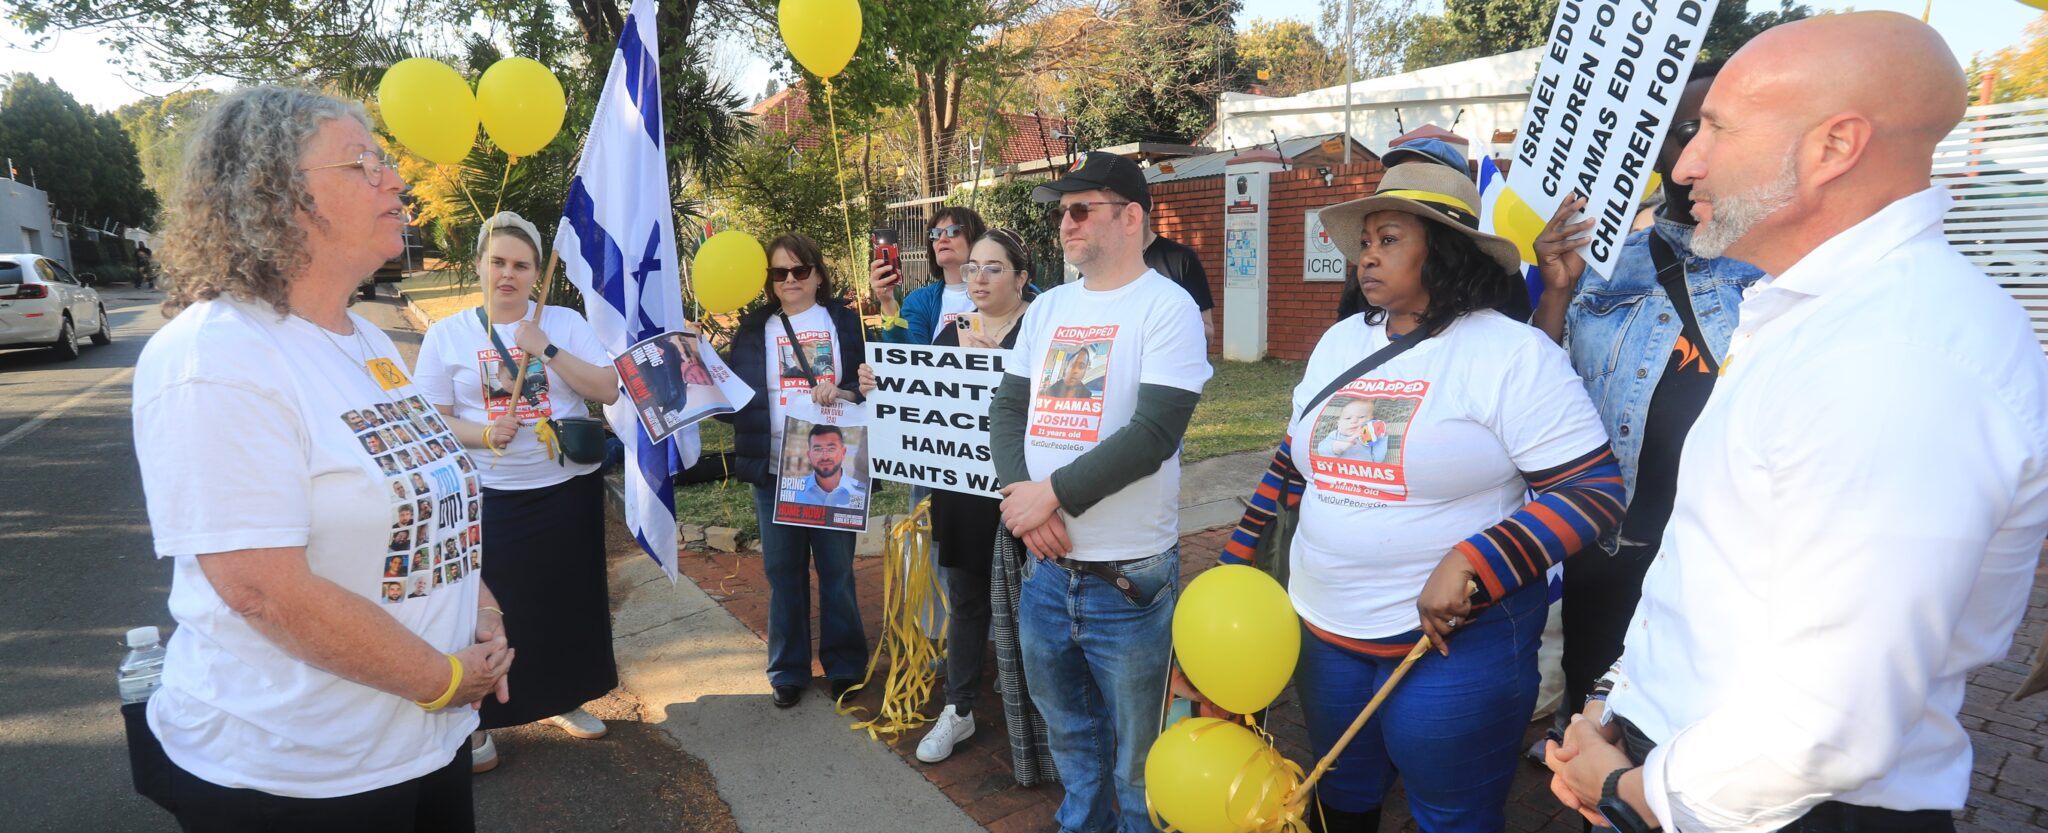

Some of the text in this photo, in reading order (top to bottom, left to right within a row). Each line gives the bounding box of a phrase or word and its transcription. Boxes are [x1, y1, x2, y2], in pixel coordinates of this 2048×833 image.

[1518, 0, 1584, 168] ISRAEL EDU
[1542, 0, 1622, 198] CHILDREN FO
[1590, 0, 1706, 263] CHILDREN FOR D
[1574, 107, 1618, 214] HAMAS
[1307, 258, 1343, 274] ICRC
[1057, 327, 1114, 339] KIDNPPED
[631, 347, 648, 365] HIM
[642, 341, 664, 367] BRING
[874, 347, 1006, 373] ISRAEL
[1036, 398, 1102, 413] BY HAMAS
[1037, 413, 1089, 429] JOSHUA
[1046, 429, 1066, 438] years
[1068, 430, 1082, 438] old
[902, 434, 991, 462] HAMAS
[872, 457, 1002, 493] WANTS WA
[1316, 460, 1396, 481] BY HAMAS
[781, 477, 806, 491] BRING
[780, 490, 796, 503] HIM
